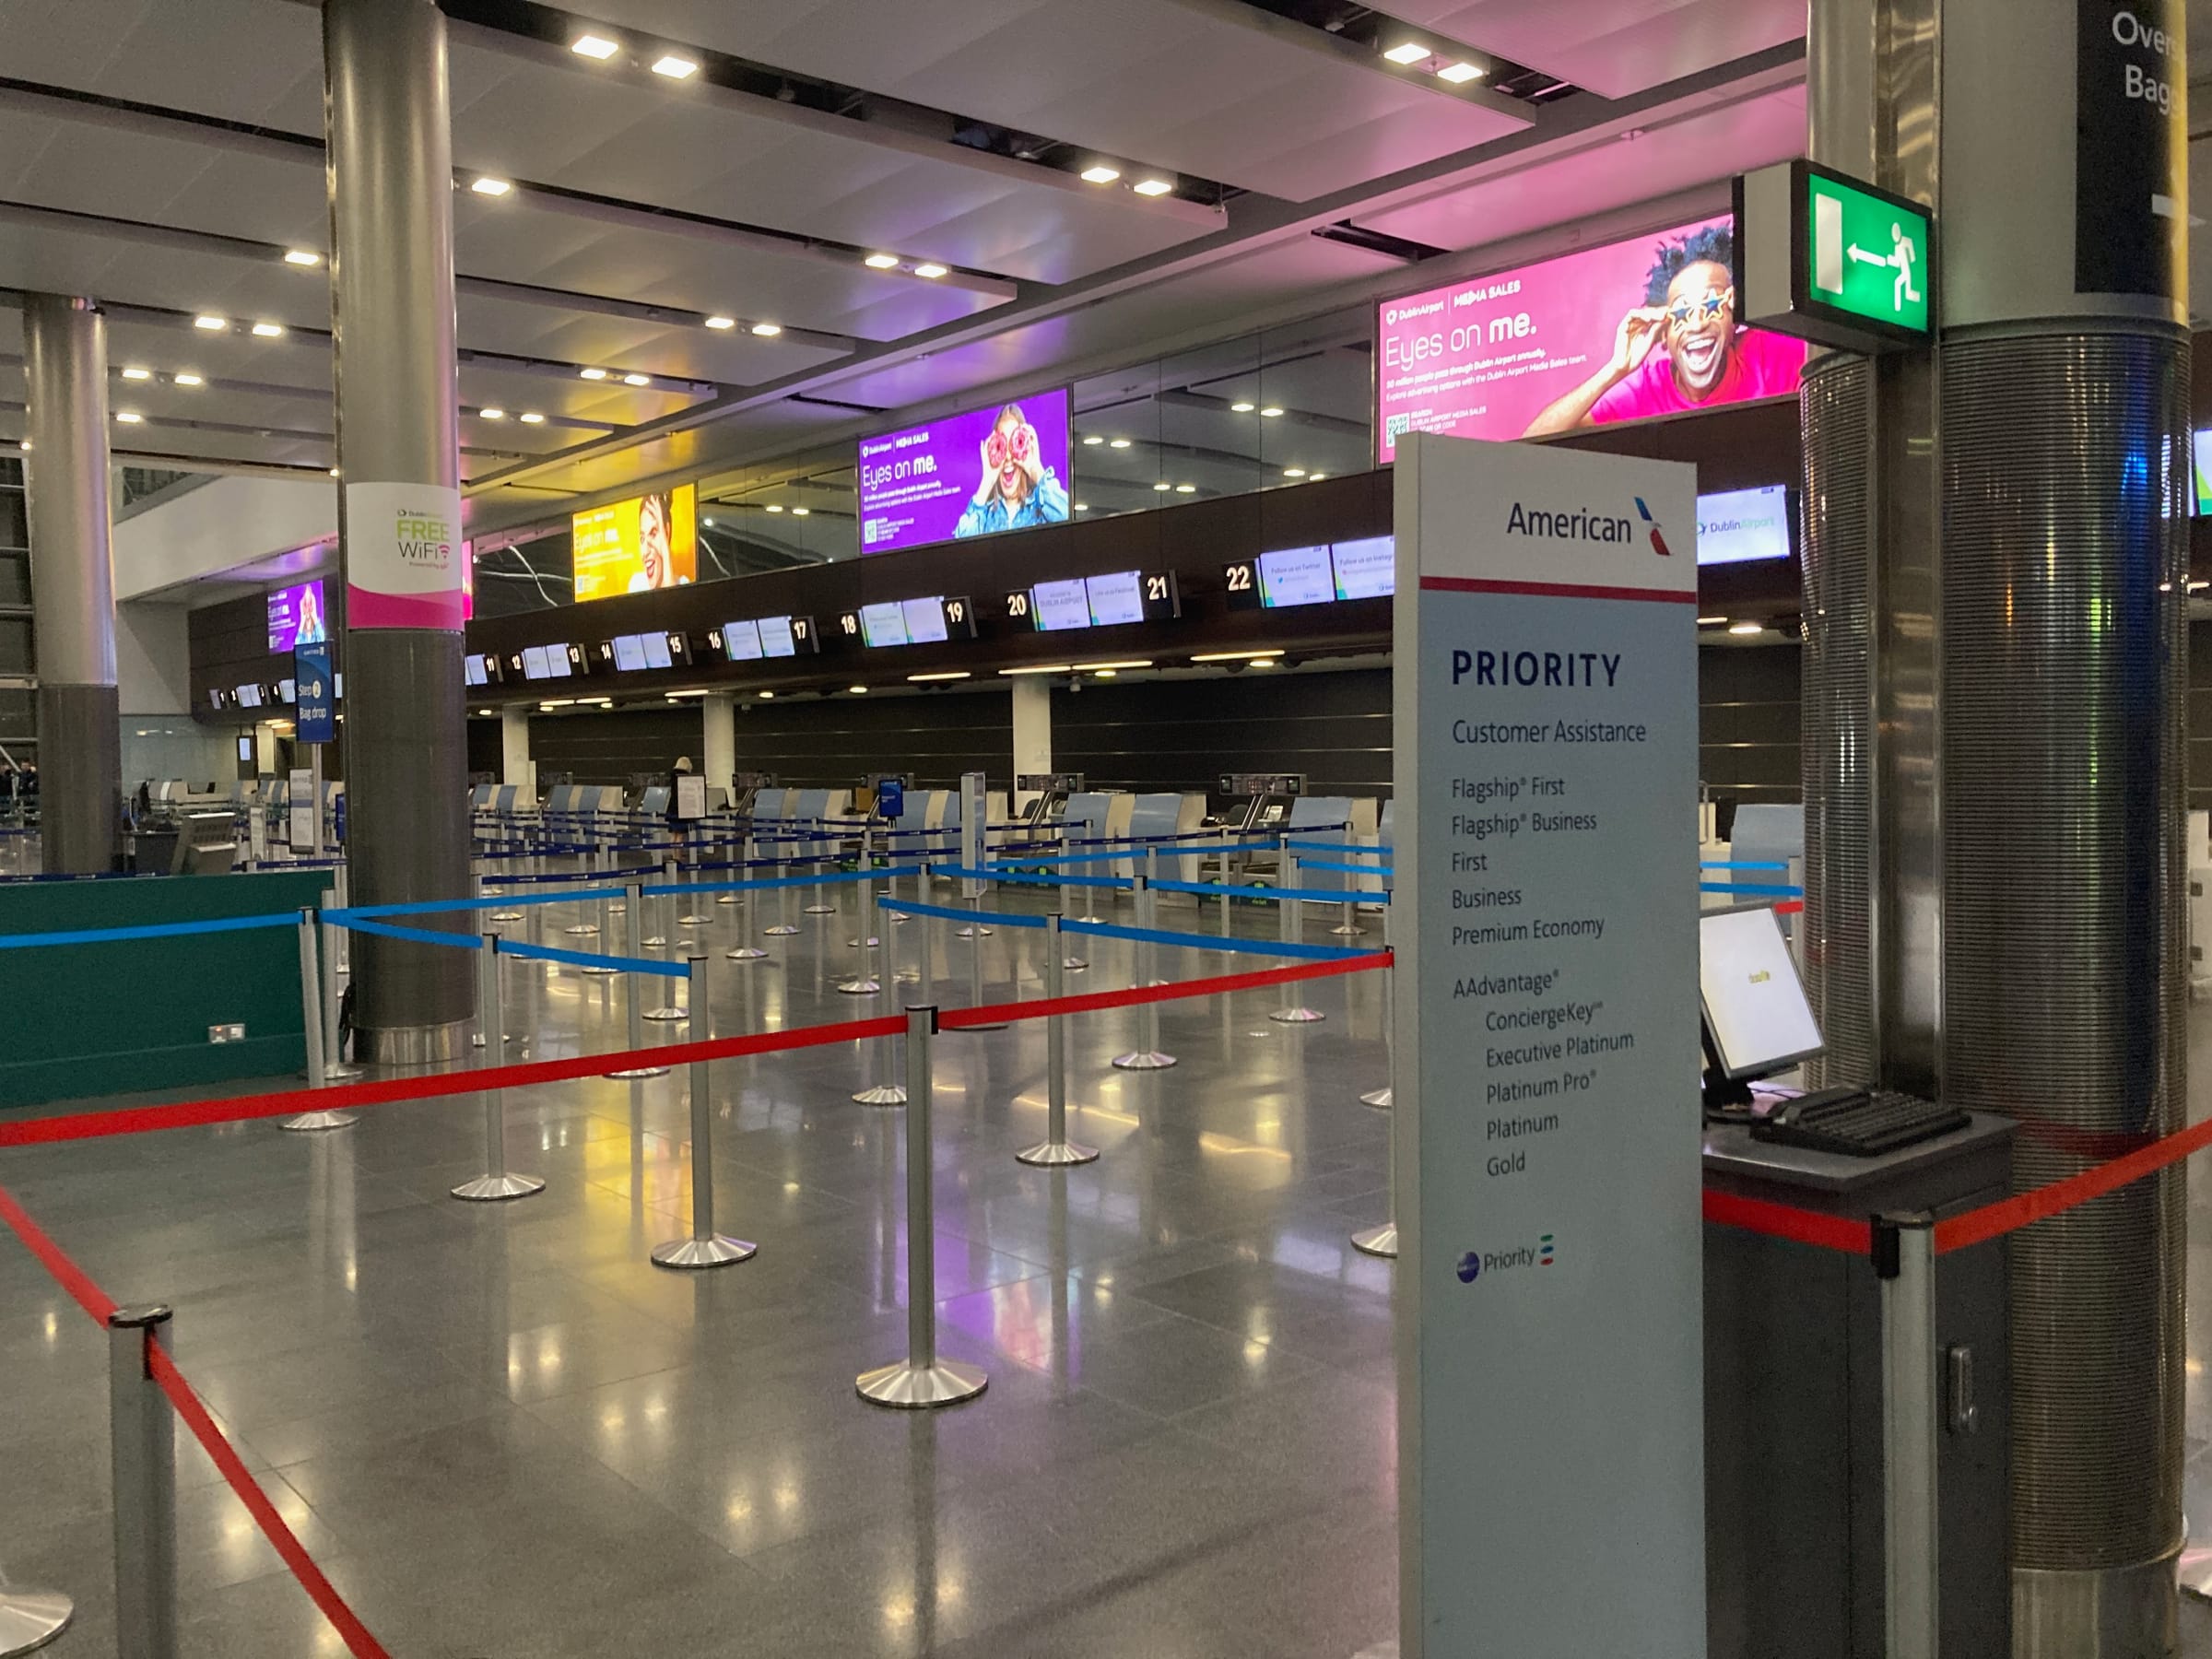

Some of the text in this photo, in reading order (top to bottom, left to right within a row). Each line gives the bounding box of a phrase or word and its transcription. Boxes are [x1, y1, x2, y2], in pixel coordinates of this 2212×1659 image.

[1453, 279, 1521, 308] MEDIA SALES
[1385, 312, 1537, 371] Eyes on me.
[1474, 359, 1494, 371] Dublin
[1494, 355, 1516, 368] Airport
[1462, 375, 1475, 386] with
[1476, 373, 1486, 382] the
[1487, 370, 1507, 381] Dublin
[1507, 364, 1528, 377] Airport
[913, 431, 929, 445] SALES
[863, 465, 892, 491] Eyes
[895, 460, 912, 480] on
[913, 453, 937, 476] me.
[396, 519, 450, 542] FREE
[1507, 502, 1632, 543] American
[397, 541, 438, 560] WiFi
[1147, 576, 1167, 600] 21
[1226, 565, 1251, 592] 22
[947, 602, 963, 623] 19
[1007, 594, 1027, 616] 20
[794, 621, 806, 640] 17
[841, 615, 856, 635] 18
[670, 636, 681, 653] 15
[708, 631, 721, 650] 16
[512, 655, 521, 670] 12
[570, 647, 580, 664] 13
[601, 644, 612, 660] 14
[1452, 649, 1621, 687] PRIORITY
[298, 684, 312, 697] Step
[300, 706, 326, 721] Bag drop
[1453, 720, 1647, 744] Customer Assistance
[1532, 777, 1566, 796] First
[1532, 812, 1597, 832] Business
[1453, 852, 1488, 872] First
[1453, 888, 1522, 909] Business
[1453, 918, 1605, 946] Premium Economy
[1486, 1032, 1634, 1067] Executive Platinum
[1487, 1078, 1558, 1104] Platinum
[1487, 1113, 1559, 1140] Platinum
[1487, 1152, 1525, 1177] Gold
[1484, 1246, 1535, 1272] Priority
